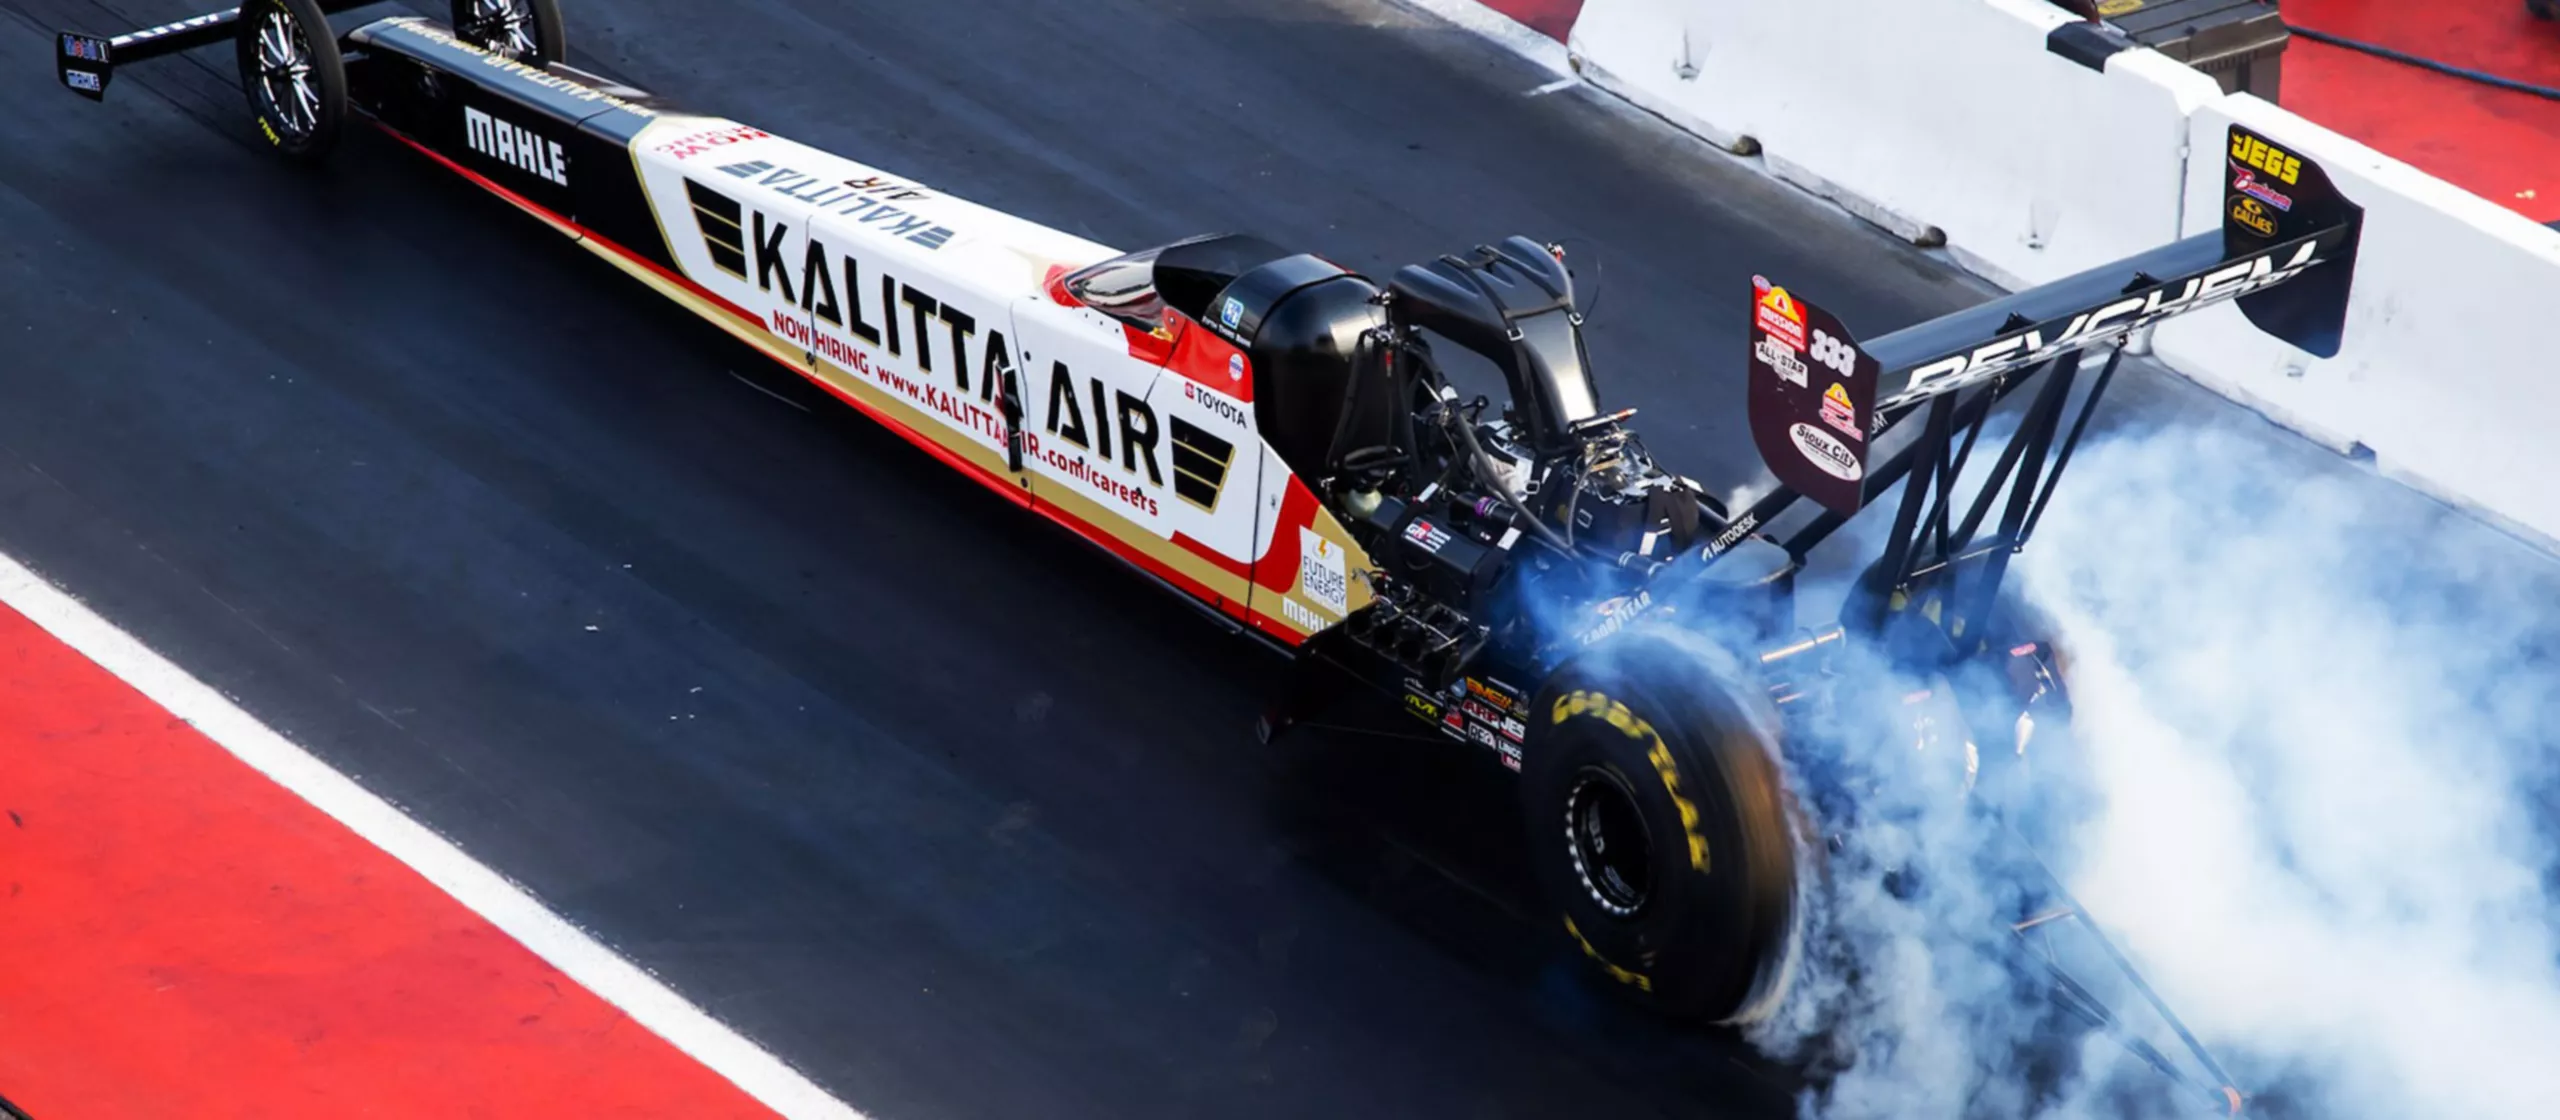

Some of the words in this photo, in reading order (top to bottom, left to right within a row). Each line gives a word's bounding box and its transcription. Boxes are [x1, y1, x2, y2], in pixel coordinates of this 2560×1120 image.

[464, 104, 568, 187] MAHLE
[2231, 134, 2301, 186] JEGS
[757, 168, 931, 236] KALITTA
[2233, 205, 2273, 234] CALLIES
[753, 209, 1024, 419] KALITTA
[1046, 359, 1165, 488] AIR
[773, 309, 810, 346] NOW
[814, 331, 870, 376] HIRING
[1811, 328, 1857, 378] 333
[1196, 387, 1248, 430] TOYOTA
[1797, 424, 1829, 451] Sioux
[1832, 444, 1857, 469] City
[1711, 513, 1760, 555] AUTODESK
[1303, 556, 1346, 591] FUTURE
[1304, 573, 1347, 608] ENERGY
[1282, 596, 1335, 634] MAHL
